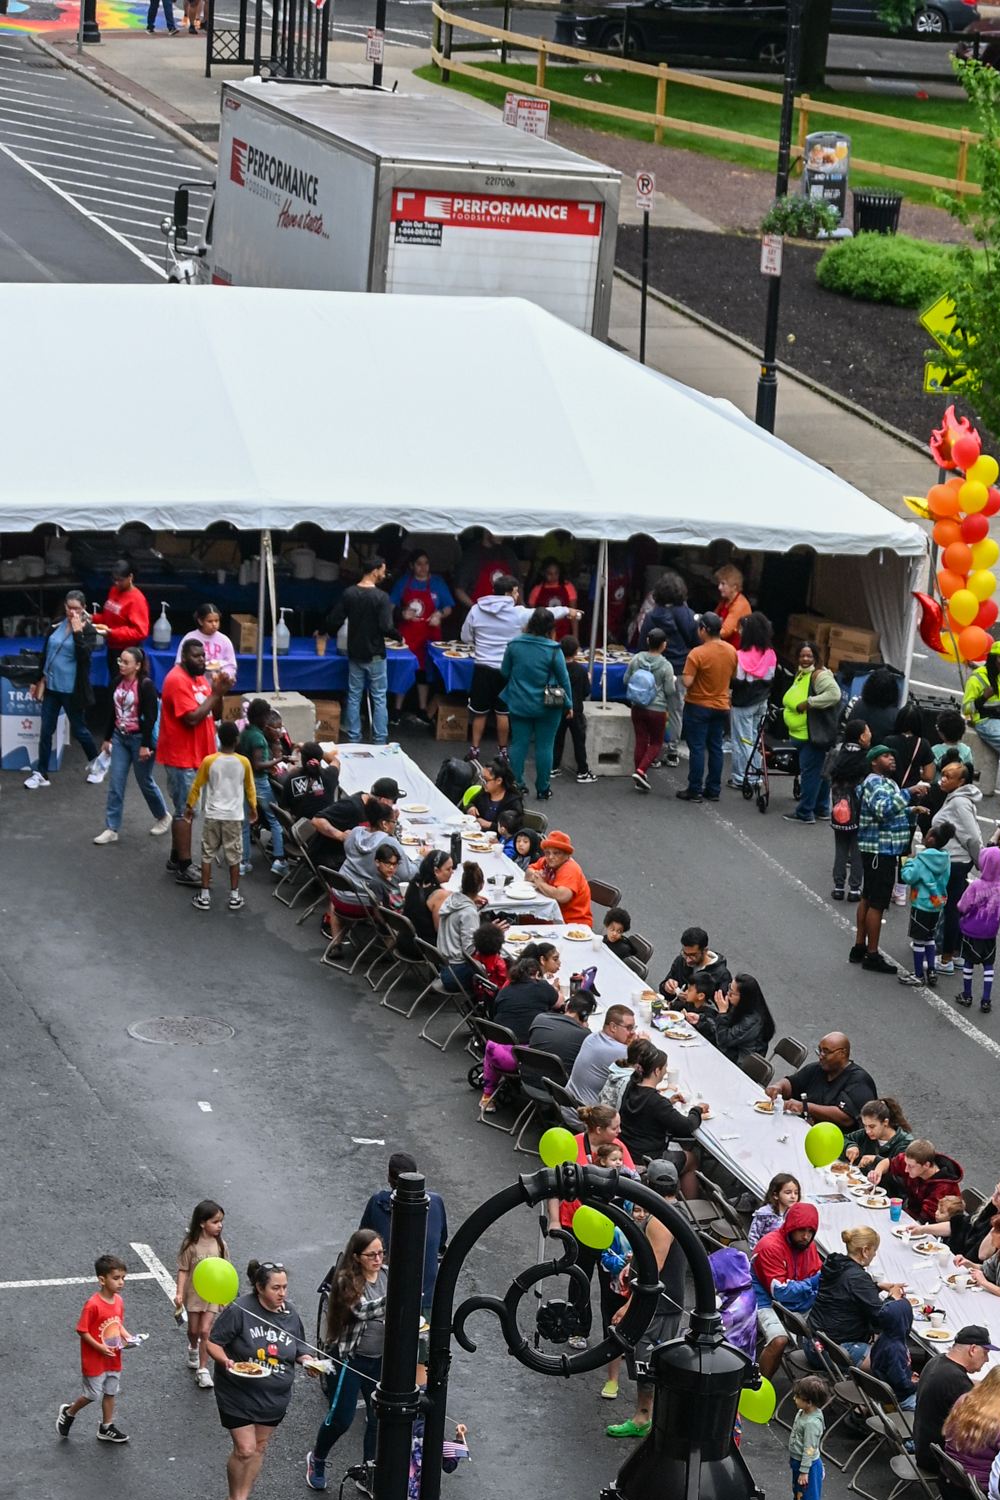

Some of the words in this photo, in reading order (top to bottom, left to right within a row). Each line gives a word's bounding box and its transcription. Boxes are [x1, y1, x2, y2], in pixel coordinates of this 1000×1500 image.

[247, 145, 319, 206] PERFORMANCE
[485, 176, 516, 187] 2217006
[452, 198, 568, 220] PERFORMANCE
[452, 213, 511, 224] FOODSERVICE
[8, 691, 38, 701] TRA
[250, 1326, 293, 1346] MIEY
